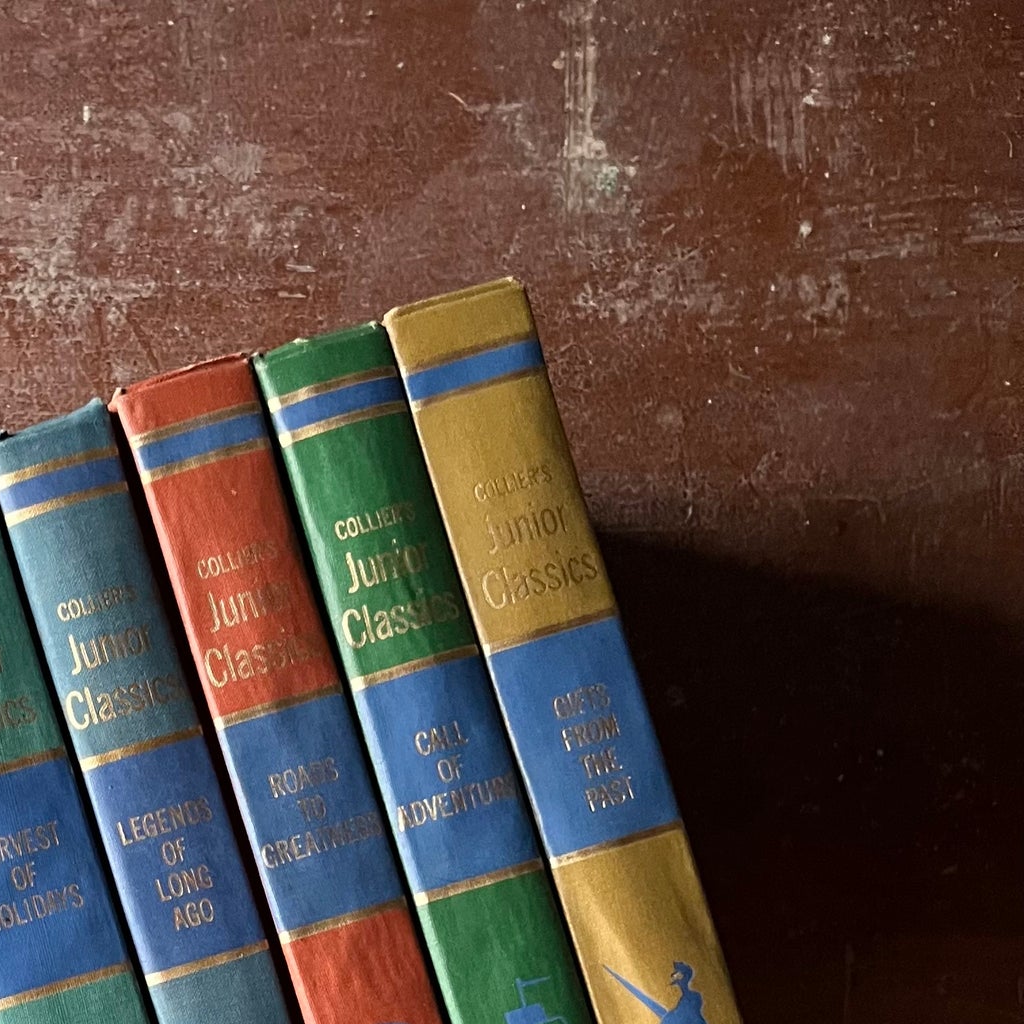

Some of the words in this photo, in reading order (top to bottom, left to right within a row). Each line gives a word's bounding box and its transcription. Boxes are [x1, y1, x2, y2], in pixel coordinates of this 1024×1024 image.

[485, 502, 569, 555] Junior
[345, 538, 428, 594] Junior
[481, 548, 599, 611] Classics
[342, 588, 460, 650] Classics
[67, 624, 152, 677] Junior
[65, 673, 186, 732] Classics
[415, 720, 469, 757] CALL
[561, 712, 622, 752] FROM
[267, 756, 339, 799] ROADS
[437, 753, 463, 784] OF
[579, 746, 623, 779] THE
[297, 793, 327, 823] TO
[585, 776, 635, 813] PAST
[116, 795, 213, 847] LEGENDS
[161, 837, 186, 867] OF
[11, 861, 38, 892] OF
[155, 864, 214, 902] LONG
[173, 898, 215, 932] AGO
